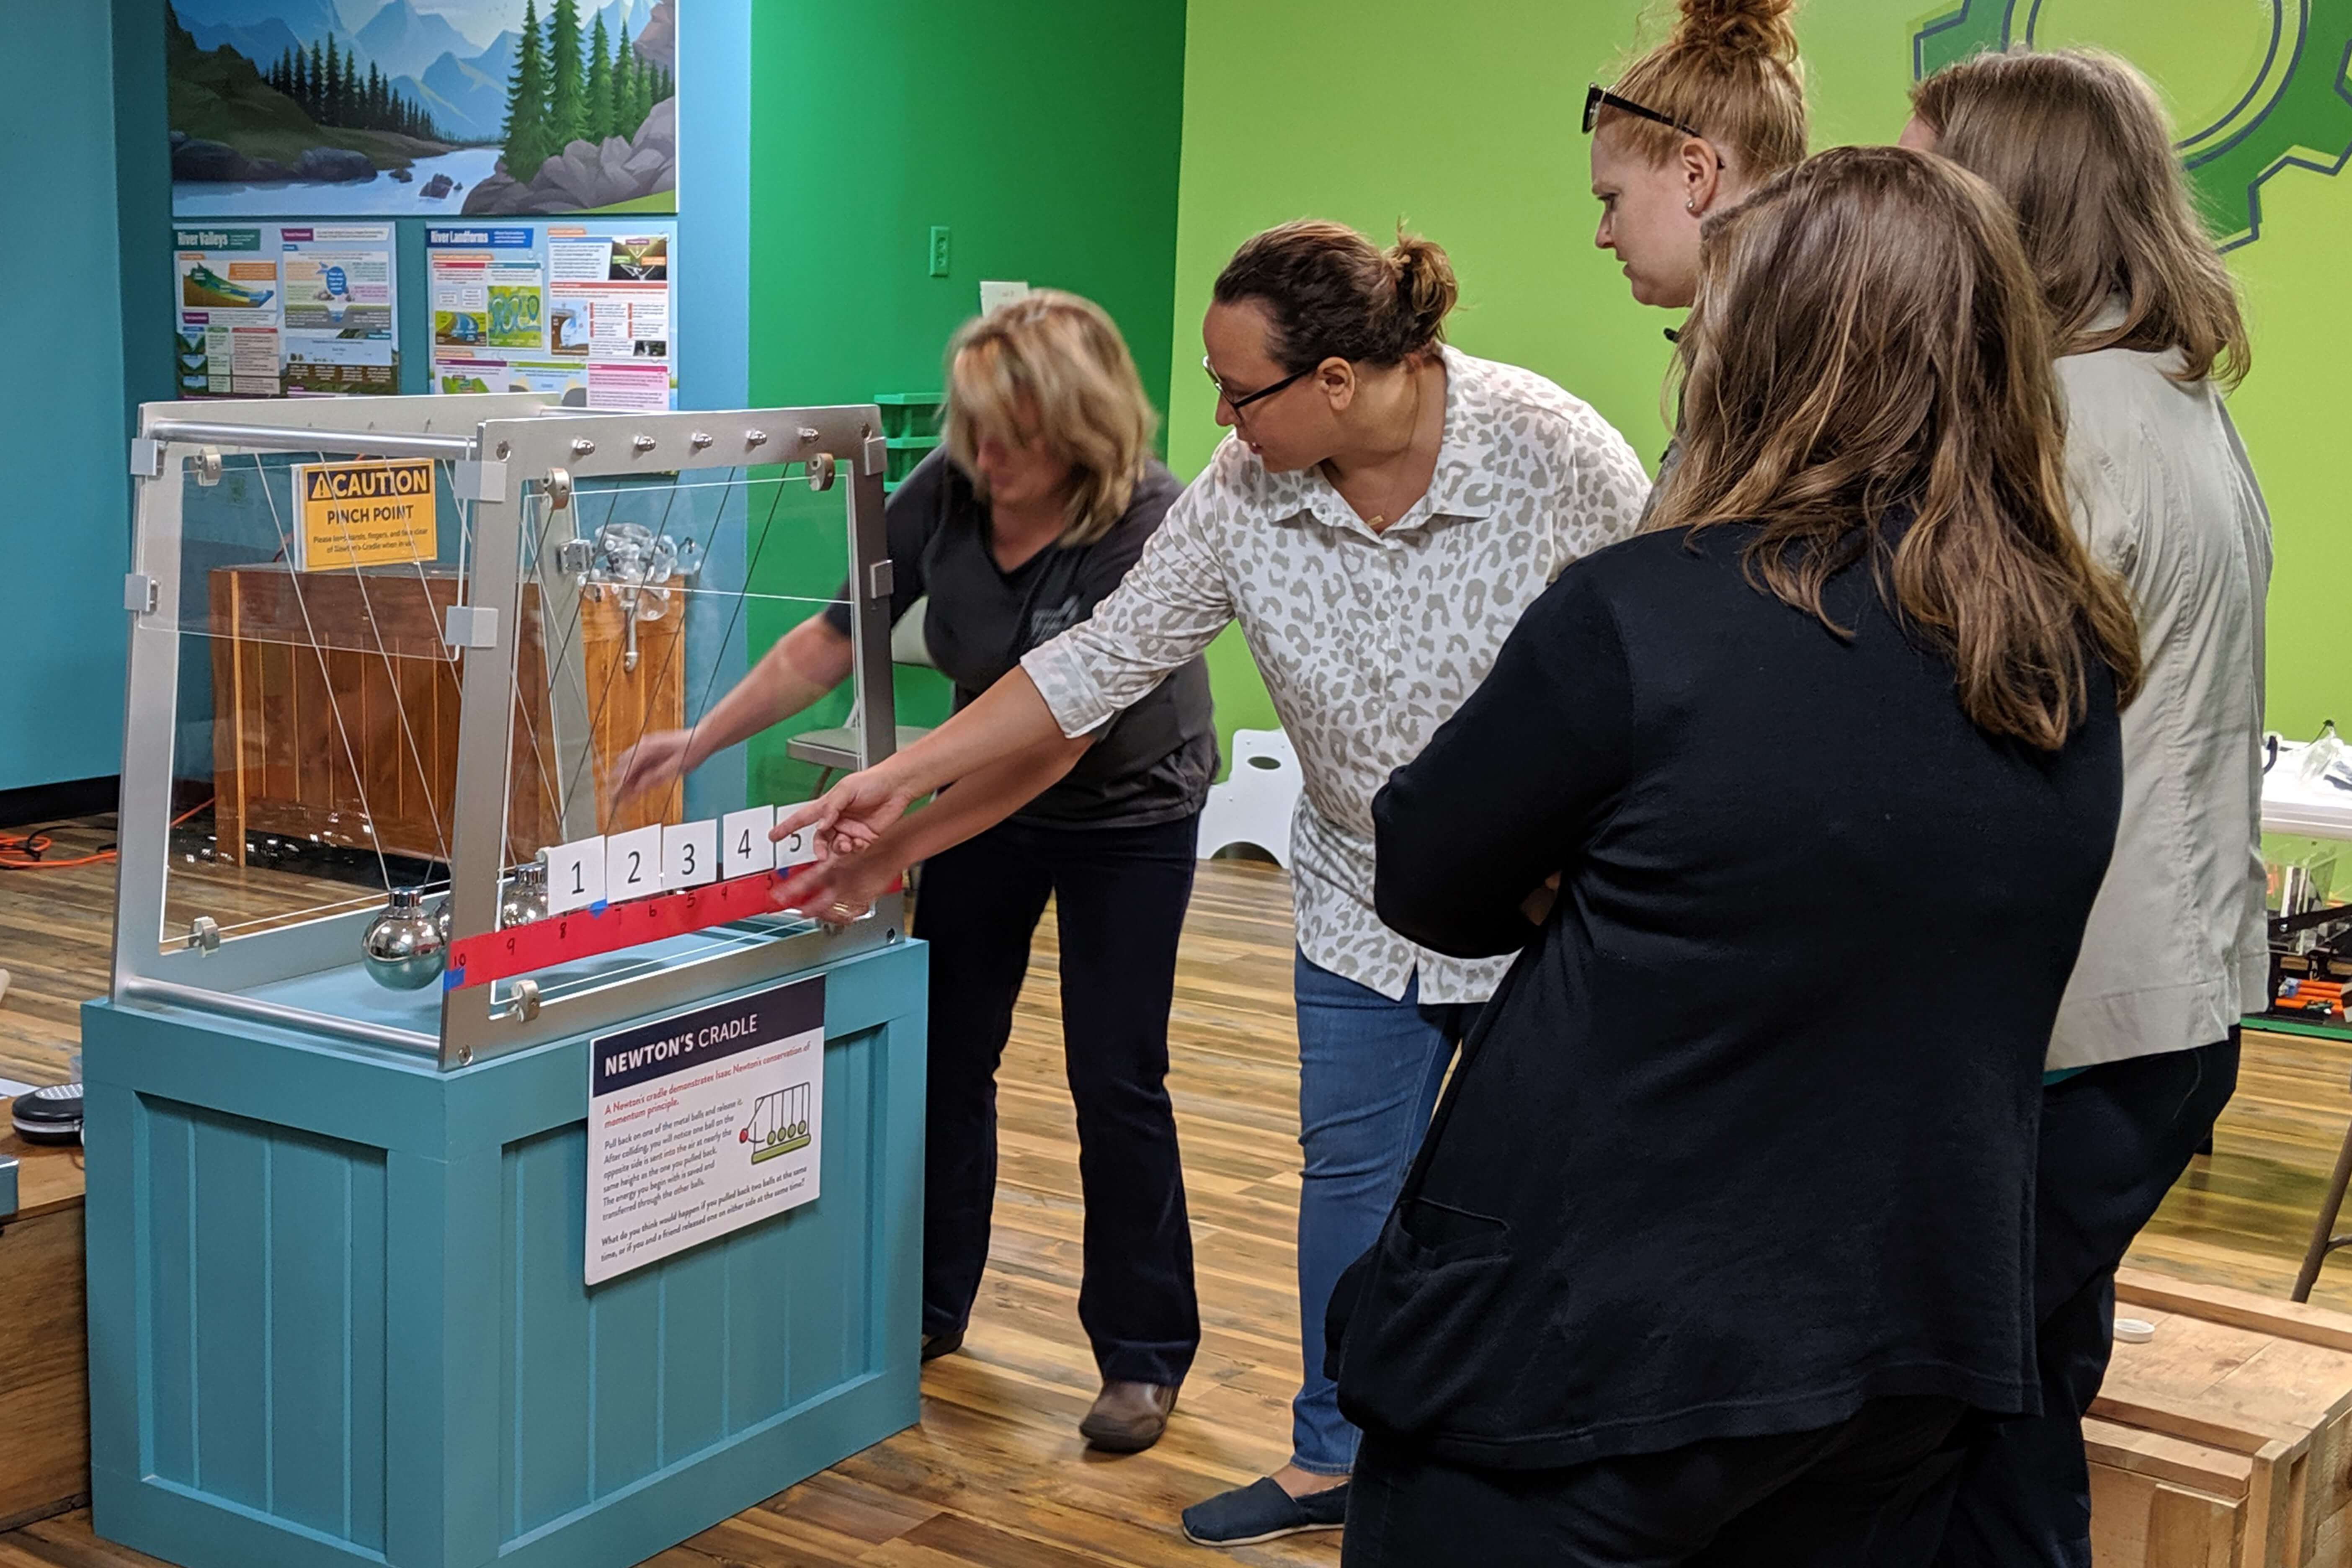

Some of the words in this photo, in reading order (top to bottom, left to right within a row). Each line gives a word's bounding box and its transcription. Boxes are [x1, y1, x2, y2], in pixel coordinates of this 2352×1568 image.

[178, 232, 198, 245] River
[199, 231, 228, 248] Valleys
[431, 231, 449, 243] River
[450, 230, 488, 243] Landforms
[333, 469, 427, 497] CAUTION
[327, 507, 369, 524] PINCH
[374, 505, 414, 522] POINT
[681, 843, 695, 875] 3
[737, 829, 752, 859] 4
[789, 832, 801, 852] 5
[571, 861, 585, 895] 1
[627, 851, 641, 884] 2
[454, 953, 466, 966] 10
[506, 937, 515, 955] 9
[560, 922, 567, 939] 8
[649, 904, 657, 917] 6
[686, 892, 696, 908] 5
[606, 1033, 693, 1076] NEWTON'S
[699, 1014, 757, 1047] CRADLE
[604, 1104, 612, 1115] A
[646, 1087, 668, 1102] cradle
[668, 1075, 714, 1095] demonstrates
[763, 1046, 802, 1065] conservation
[803, 1040, 811, 1052] of
[604, 1109, 646, 1129] momentum
[647, 1096, 679, 1119] principle.
[604, 1138, 617, 1150] Pull
[618, 1133, 632, 1146] back
[642, 1129, 653, 1137] one
[654, 1122, 662, 1134] of
[662, 1121, 673, 1131] the
[673, 1114, 690, 1127] metal
[691, 1110, 704, 1122] balls
[705, 1105, 716, 1117] and
[717, 1101, 736, 1112] release
[603, 1153, 621, 1165] After
[650, 1140, 661, 1152] you
[662, 1133, 673, 1144] will
[673, 1130, 692, 1140] notice
[693, 1126, 704, 1135] one
[704, 1119, 715, 1131] ball
[724, 1114, 734, 1124] the
[630, 1158, 643, 1170] side
[663, 1149, 676, 1158] into
[676, 1144, 687, 1154] the
[722, 1128, 732, 1138] the
[603, 1196, 615, 1207] The
[615, 1190, 637, 1202] energy
[637, 1186, 649, 1199] you
[650, 1179, 666, 1191] begin
[667, 1172, 681, 1183] with
[704, 1159, 715, 1171] and
[620, 1173, 640, 1187] height
[648, 1167, 659, 1177] the
[659, 1164, 671, 1173] one
[672, 1161, 683, 1172] you
[683, 1150, 702, 1168] pulled
[702, 1145, 717, 1158] back.
[601, 1235, 619, 1247] What
[619, 1230, 628, 1240] do
[628, 1228, 641, 1240] you
[641, 1218, 658, 1233] think
[659, 1211, 677, 1225] would
[701, 1200, 707, 1210] if
[706, 1199, 717, 1212] you
[718, 1189, 736, 1207] pulled
[737, 1185, 750, 1197] back
[751, 1183, 762, 1191] two
[762, 1176, 776, 1187] balls
[783, 1171, 792, 1180] the
[602, 1200, 637, 1221] transferred
[637, 1192, 662, 1209] through
[662, 1189, 673, 1199] the
[673, 1184, 689, 1196] other
[690, 1178, 705, 1189] balls.
[626, 1241, 632, 1252] if
[632, 1241, 645, 1253] you
[645, 1233, 657, 1245] and
[662, 1224, 681, 1238] friend
[681, 1215, 706, 1231] released
[707, 1213, 717, 1222] one
[745, 1197, 756, 1208] side
[763, 1191, 774, 1201] the
